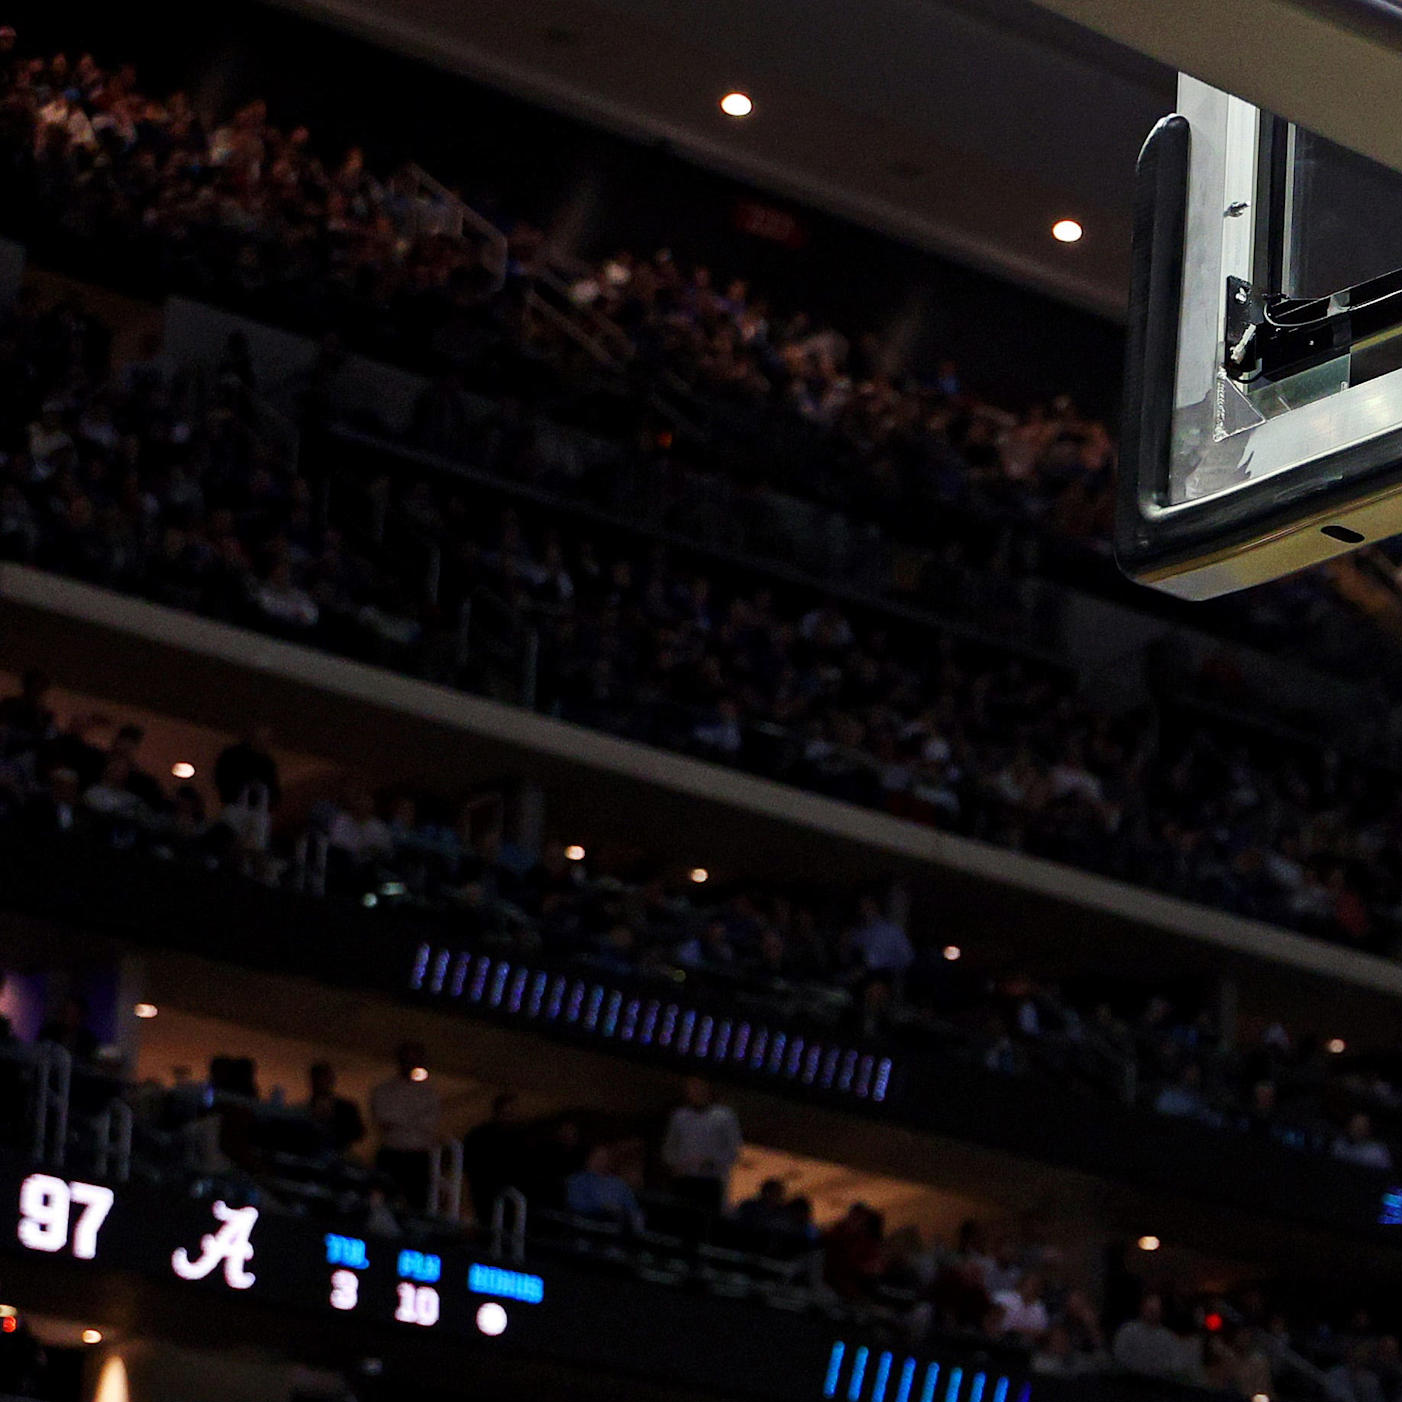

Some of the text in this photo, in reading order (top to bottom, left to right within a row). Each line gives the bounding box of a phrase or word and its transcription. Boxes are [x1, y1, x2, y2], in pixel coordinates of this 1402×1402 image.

[17, 1173, 115, 1260] 97
[330, 1268, 440, 1327] 3 10
